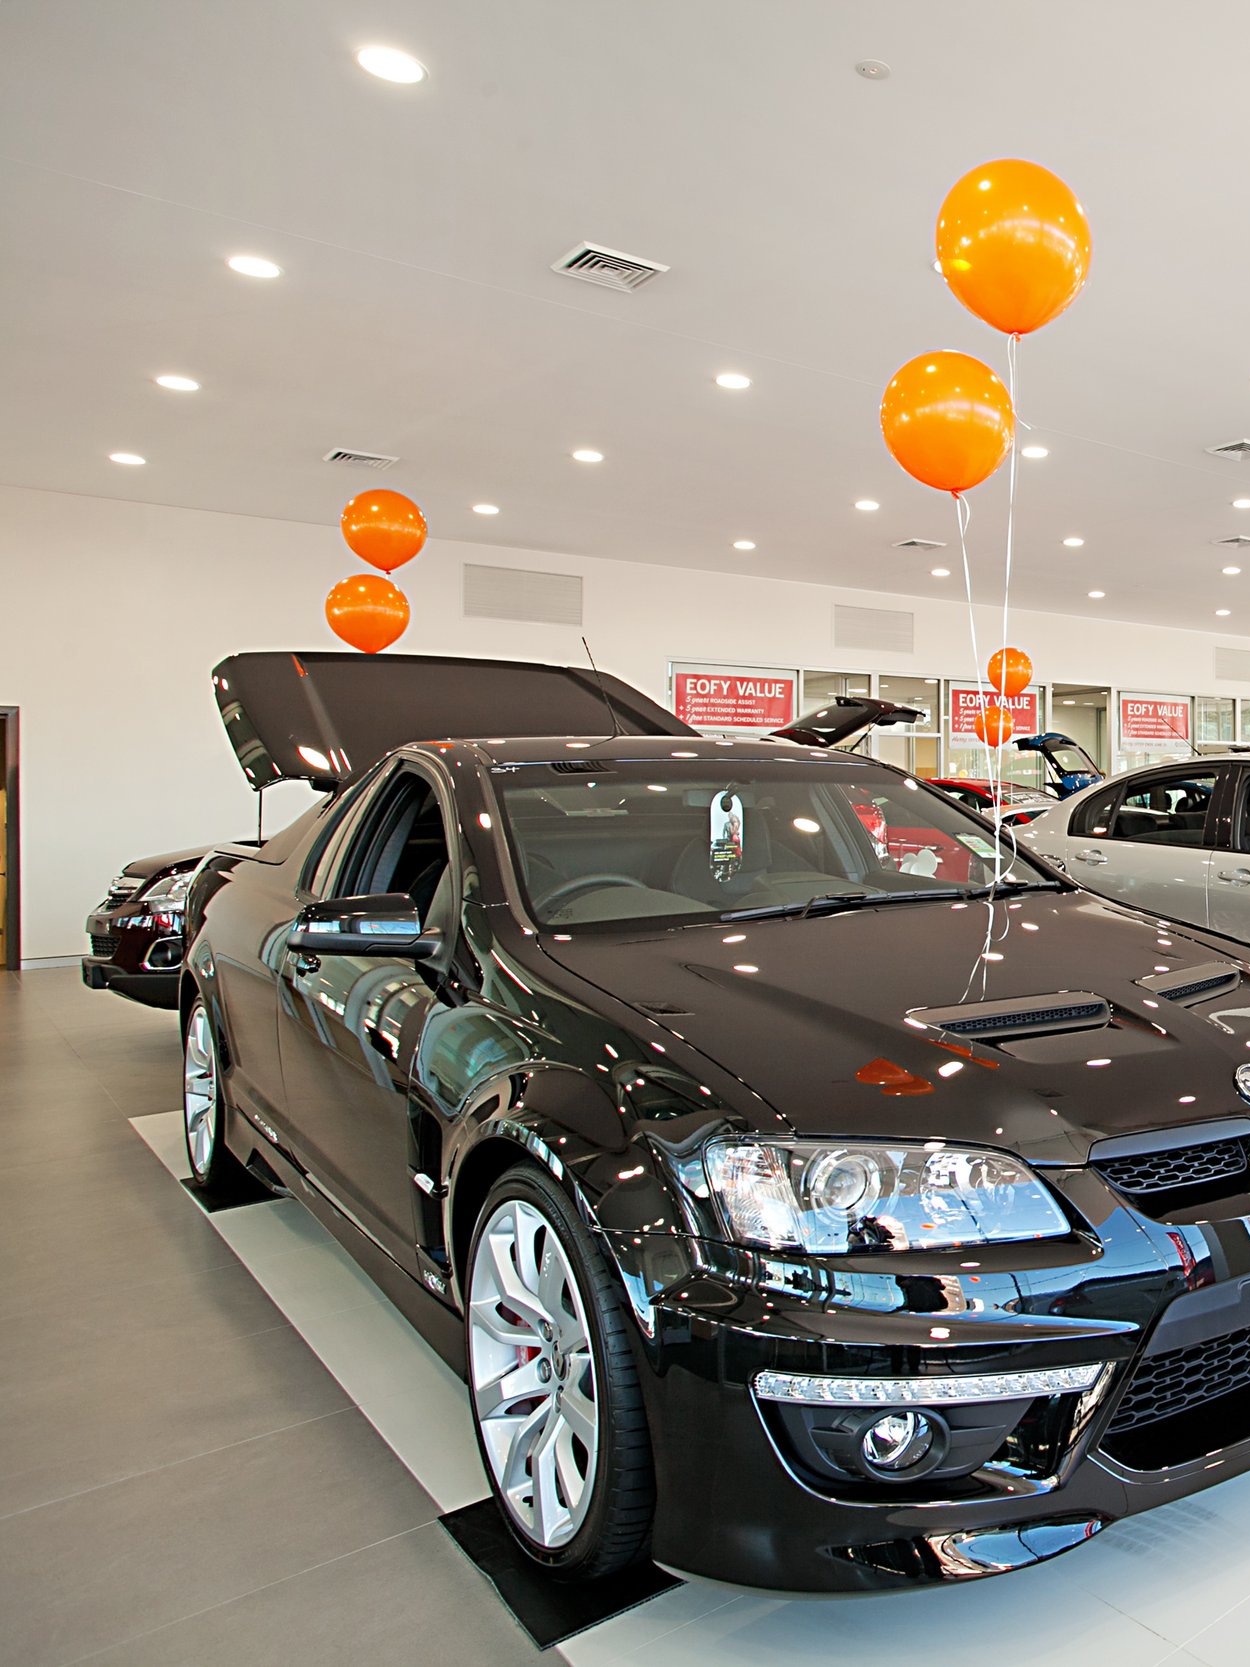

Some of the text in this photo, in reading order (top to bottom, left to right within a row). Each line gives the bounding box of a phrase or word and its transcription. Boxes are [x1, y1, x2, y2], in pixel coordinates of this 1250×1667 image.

[686, 679, 785, 698] EOFY VALUE
[685, 695, 691, 703] 5
[994, 696, 1031, 709] VALUE
[1127, 703, 1184, 717] EOFY VALUE
